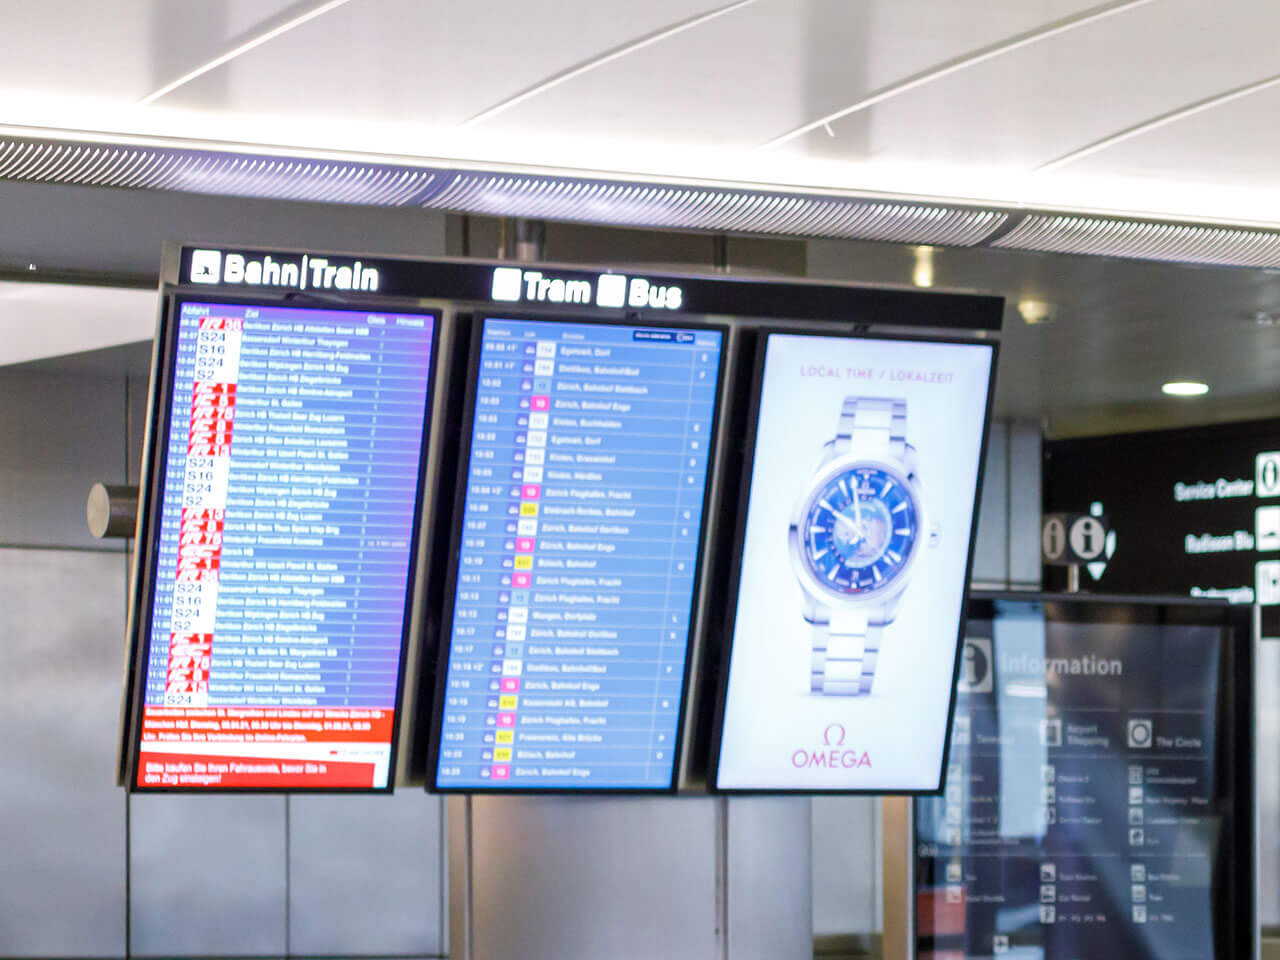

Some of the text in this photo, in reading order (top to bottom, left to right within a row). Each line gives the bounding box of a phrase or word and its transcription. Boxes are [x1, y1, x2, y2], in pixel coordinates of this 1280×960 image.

[523, 271, 682, 309] Tram Bus
[201, 332, 225, 341] S24
[200, 345, 225, 354] S16
[198, 357, 223, 367] S24
[197, 370, 214, 380] S2
[800, 365, 841, 379] LOCAL
[847, 367, 875, 380] TIME
[890, 369, 955, 384] LOKALZEIT
[188, 458, 214, 468] S24
[188, 471, 213, 481] S16
[186, 484, 212, 494] S24
[1175, 479, 1254, 502] Service Center
[186, 496, 202, 506] S2
[177, 584, 202, 592] S24
[176, 596, 201, 605] S16
[176, 609, 200, 618] S24
[174, 622, 191, 630] S2
[1001, 654, 1122, 676] Information
[168, 696, 192, 704] S24
[792, 750, 872, 769] OMEGA
